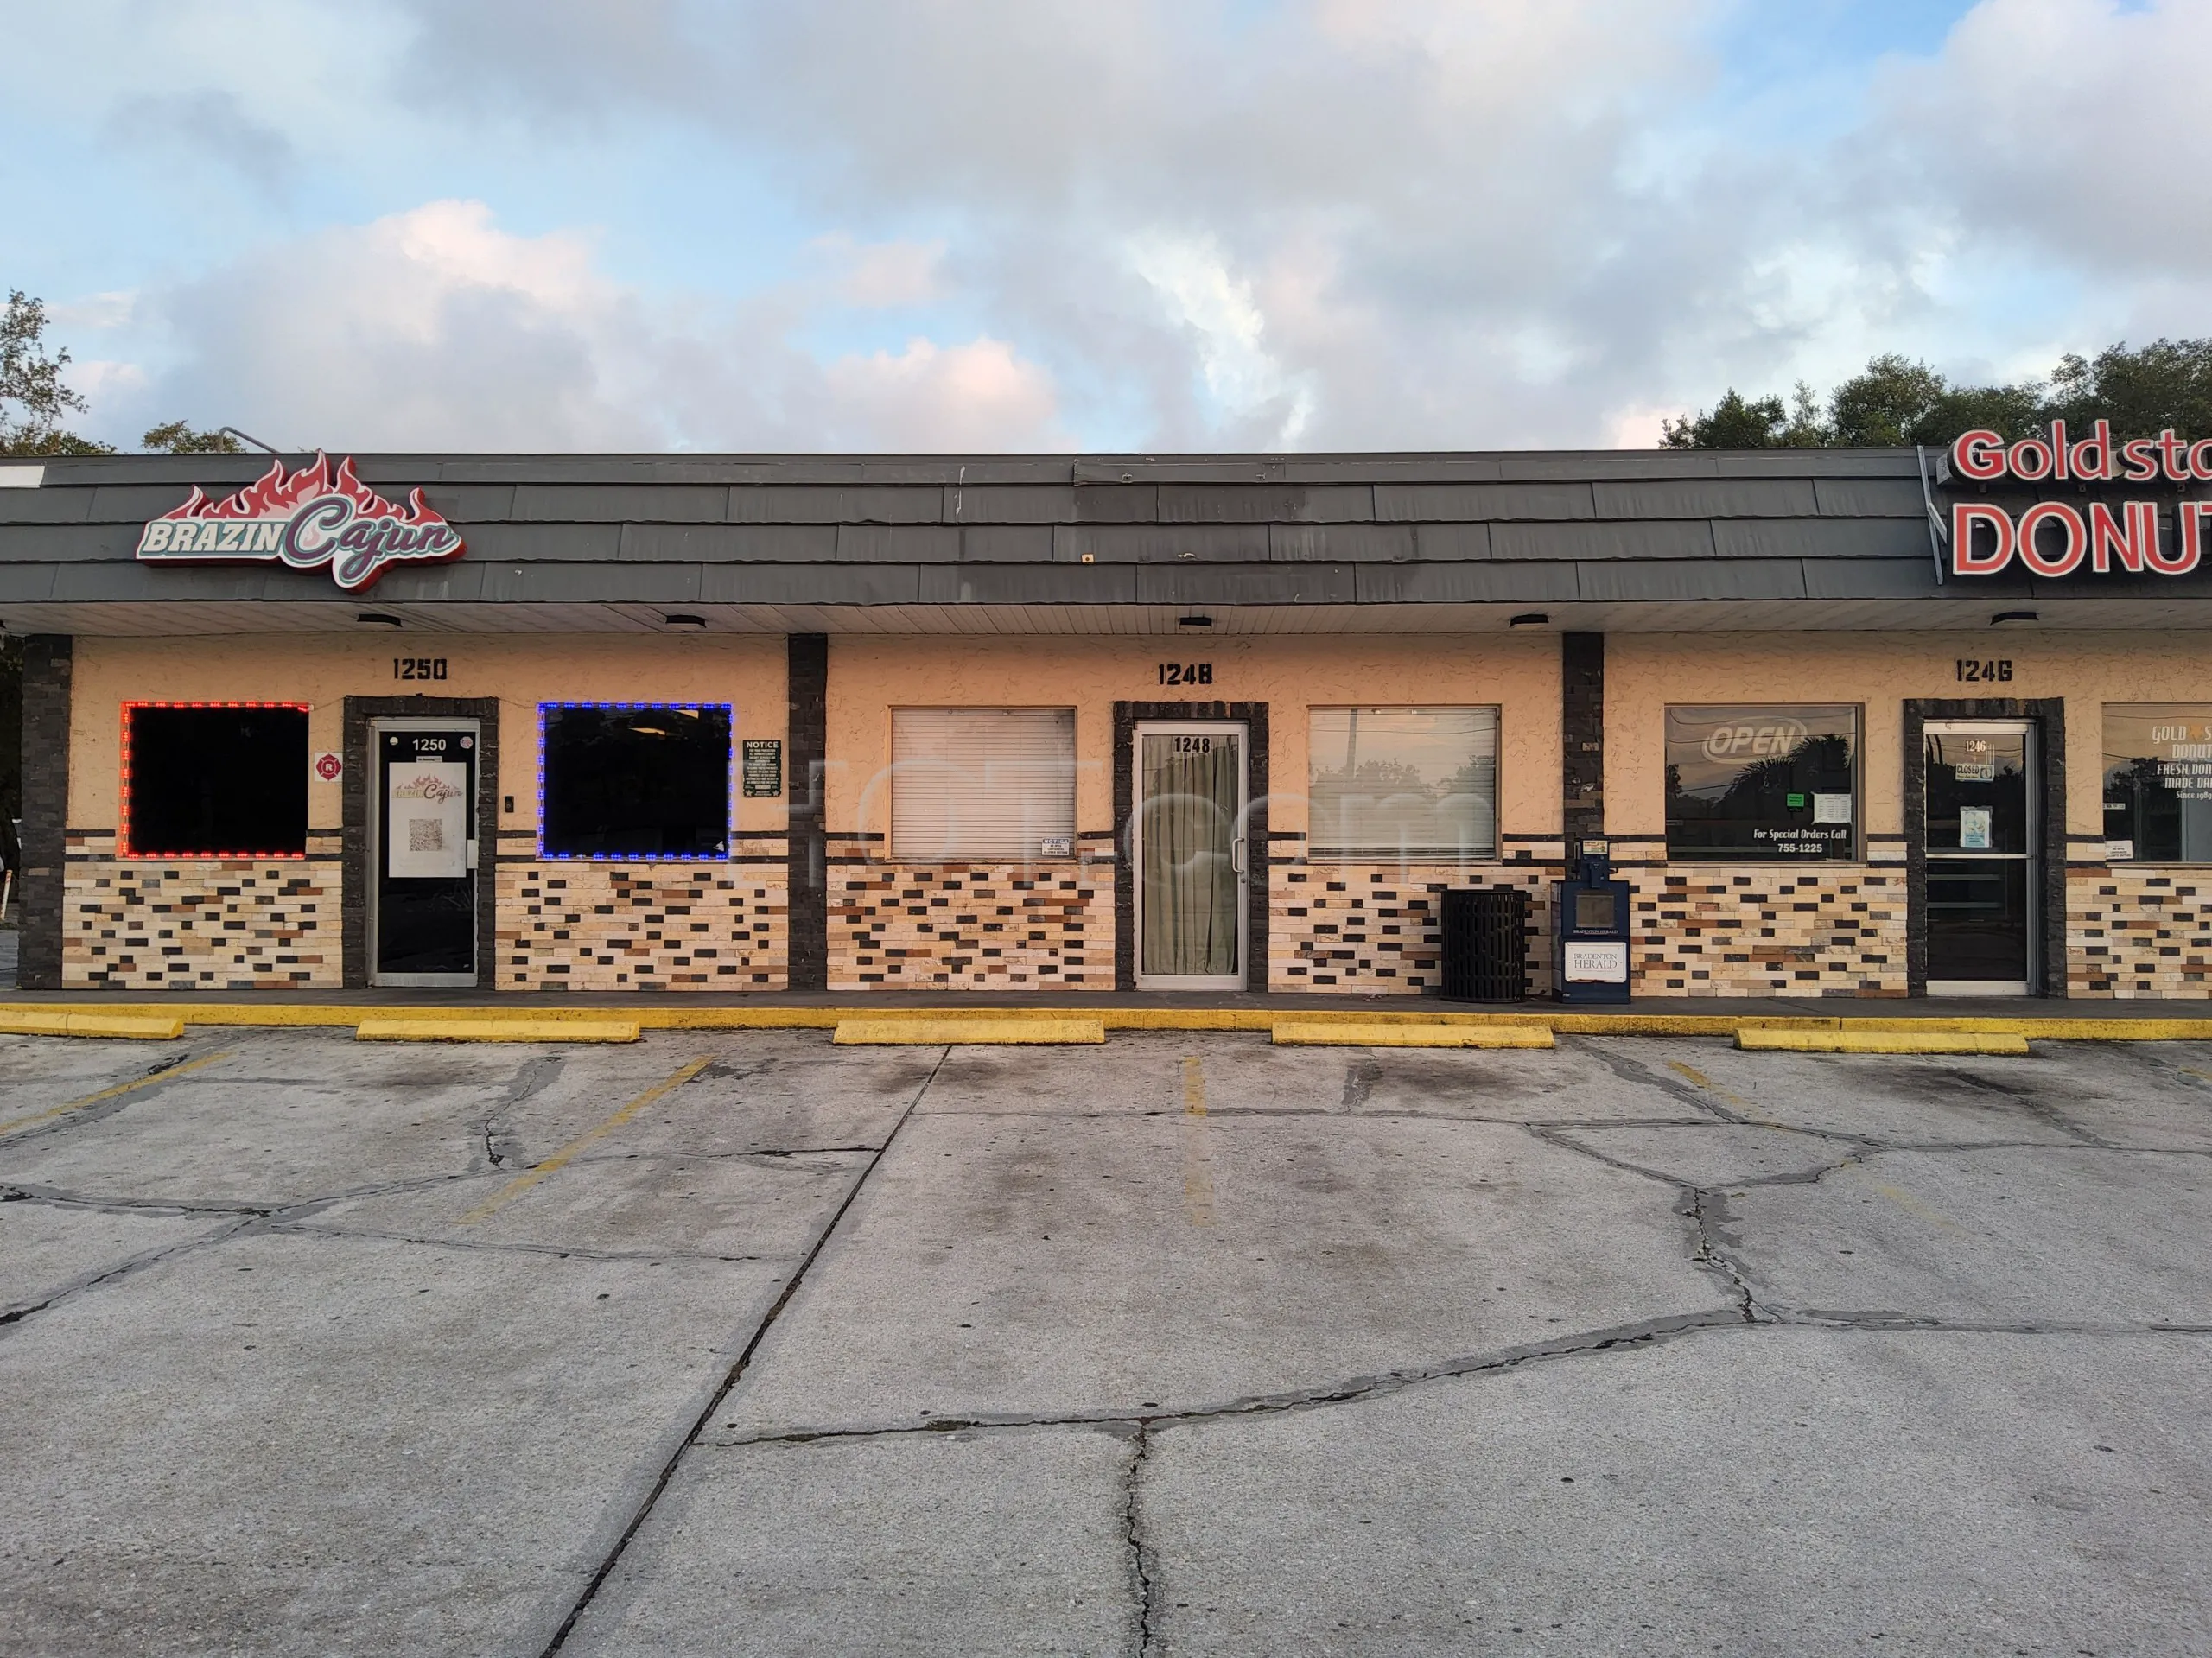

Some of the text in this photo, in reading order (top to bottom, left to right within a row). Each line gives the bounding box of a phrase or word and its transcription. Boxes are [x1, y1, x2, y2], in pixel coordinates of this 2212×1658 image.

[141, 496, 458, 581] BRAZIN Cajun
[1953, 501, 2212, 577] DONU
[394, 658, 448, 680] 1250
[1159, 664, 1213, 685] 1248
[1956, 659, 2012, 682] 1246
[1708, 727, 1797, 754] OPEN
[2152, 725, 2187, 744] GOLD
[412, 738, 447, 751] 1250
[1174, 737, 1211, 753] 1248
[1966, 740, 1986, 752] 1246
[1956, 765, 1980, 775] CLOSED
[2157, 764, 2190, 775] FRESH
[2164, 778, 2195, 789] MADE
[1753, 829, 1847, 841] For Special Orders Call
[1777, 843, 1823, 853] 755-1225
[1574, 960, 1618, 969] HERALD
